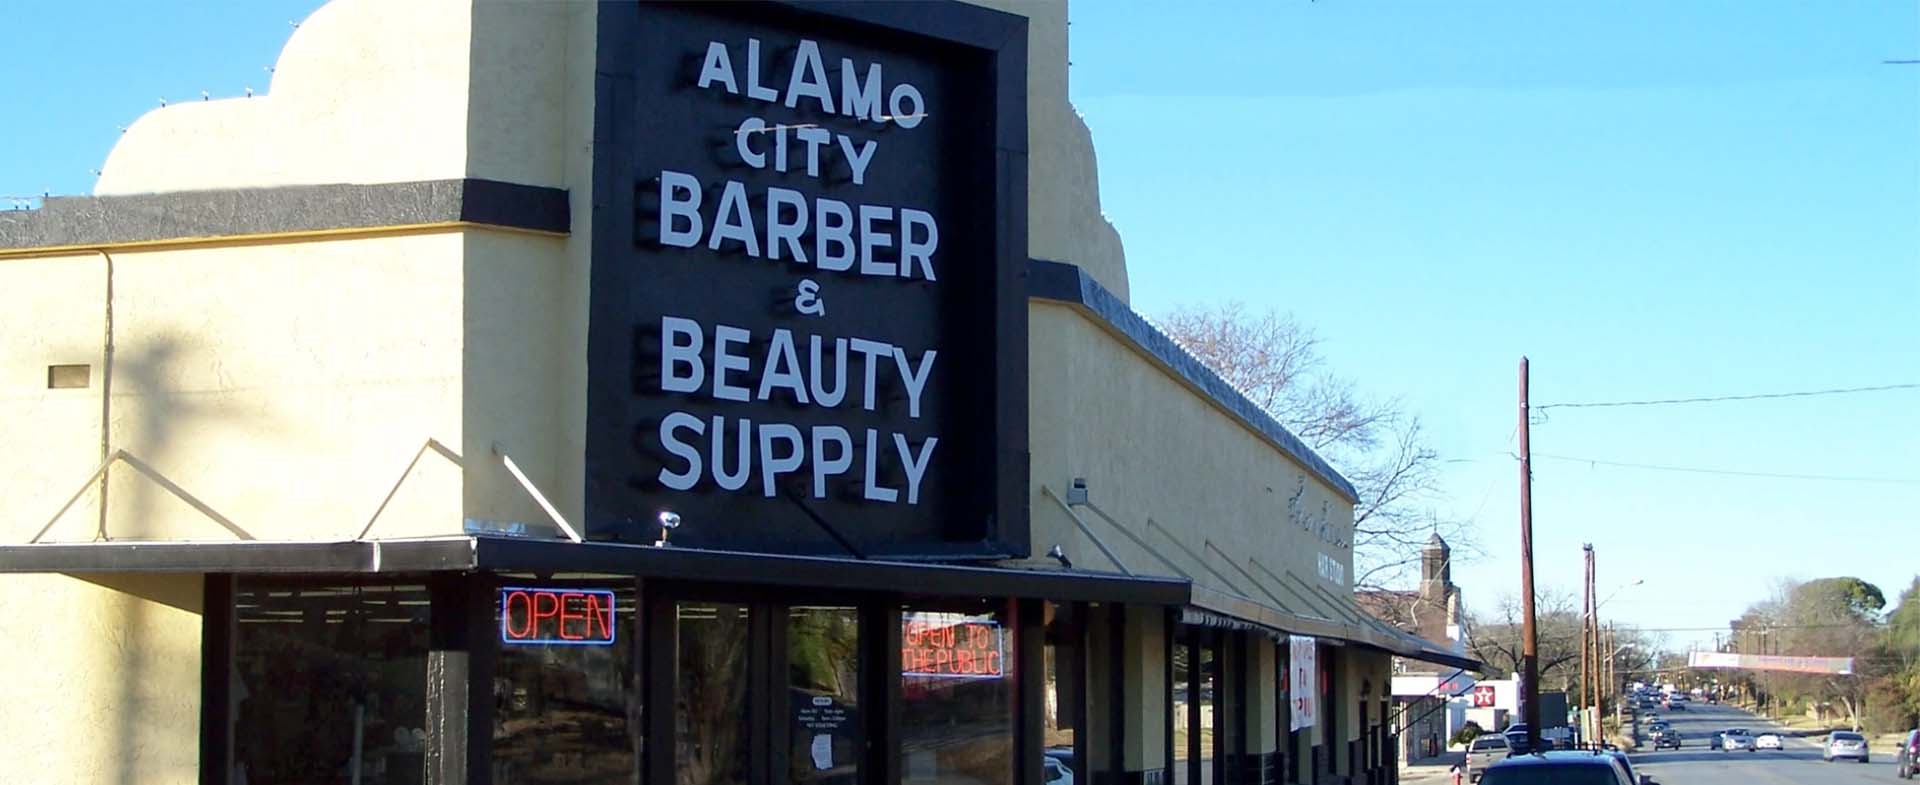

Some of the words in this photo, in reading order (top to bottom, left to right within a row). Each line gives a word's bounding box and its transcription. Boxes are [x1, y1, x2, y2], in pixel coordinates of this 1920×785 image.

[698, 38, 929, 129] ALAMO
[735, 117, 877, 185] CITY
[660, 170, 938, 281] BARBER
[794, 279, 825, 317] &
[661, 316, 937, 418] BEAUTY
[658, 411, 938, 505] SUPPLY
[507, 591, 611, 640] OPEN
[906, 621, 955, 648] OPEN
[965, 624, 989, 649] TO
